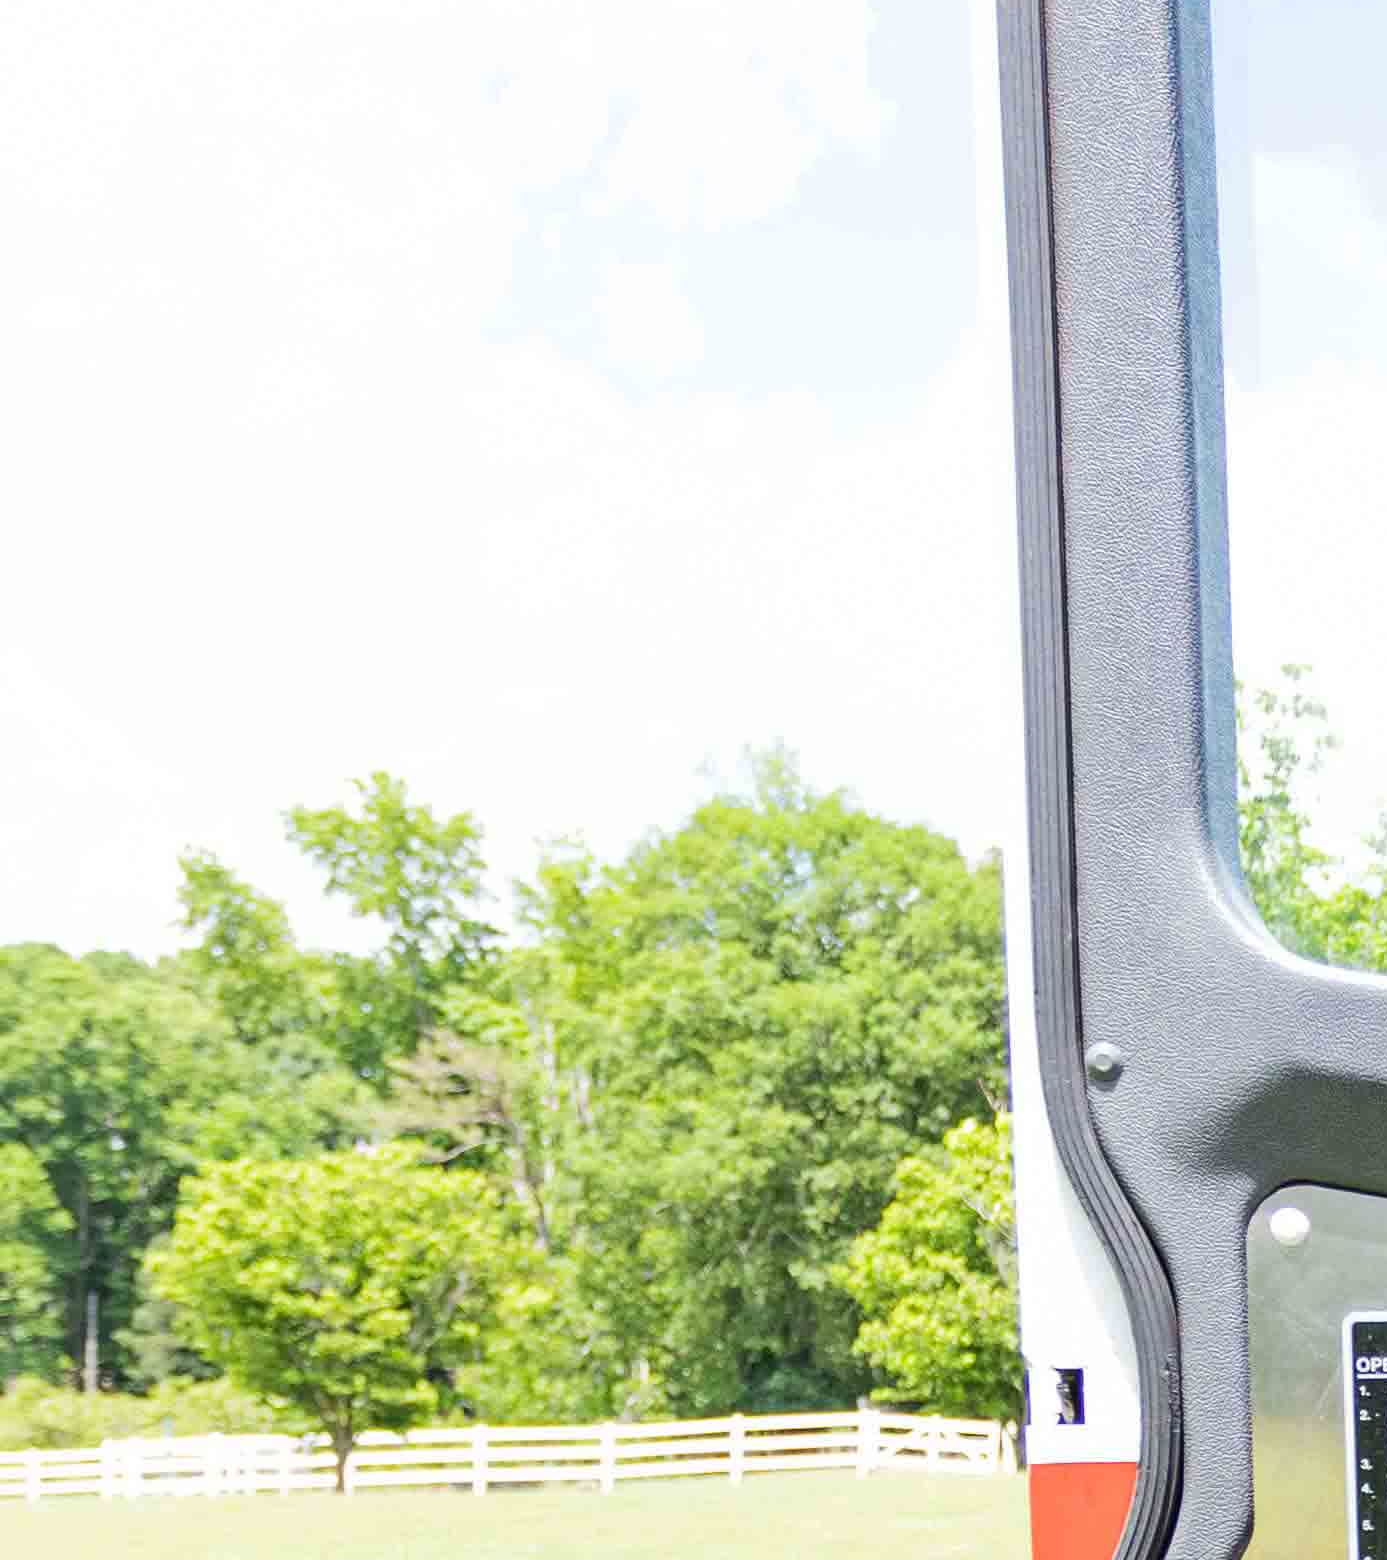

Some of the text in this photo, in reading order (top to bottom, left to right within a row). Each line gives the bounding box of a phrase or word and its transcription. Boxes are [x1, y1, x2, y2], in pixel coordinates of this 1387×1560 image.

[1360, 1385, 1371, 1396] 1.
[1359, 1410, 1371, 1420] 2.
[1360, 1459, 1373, 1470] 3.
[1361, 1483, 1373, 1494] 4.
[1362, 1520, 1375, 1531] 5.
